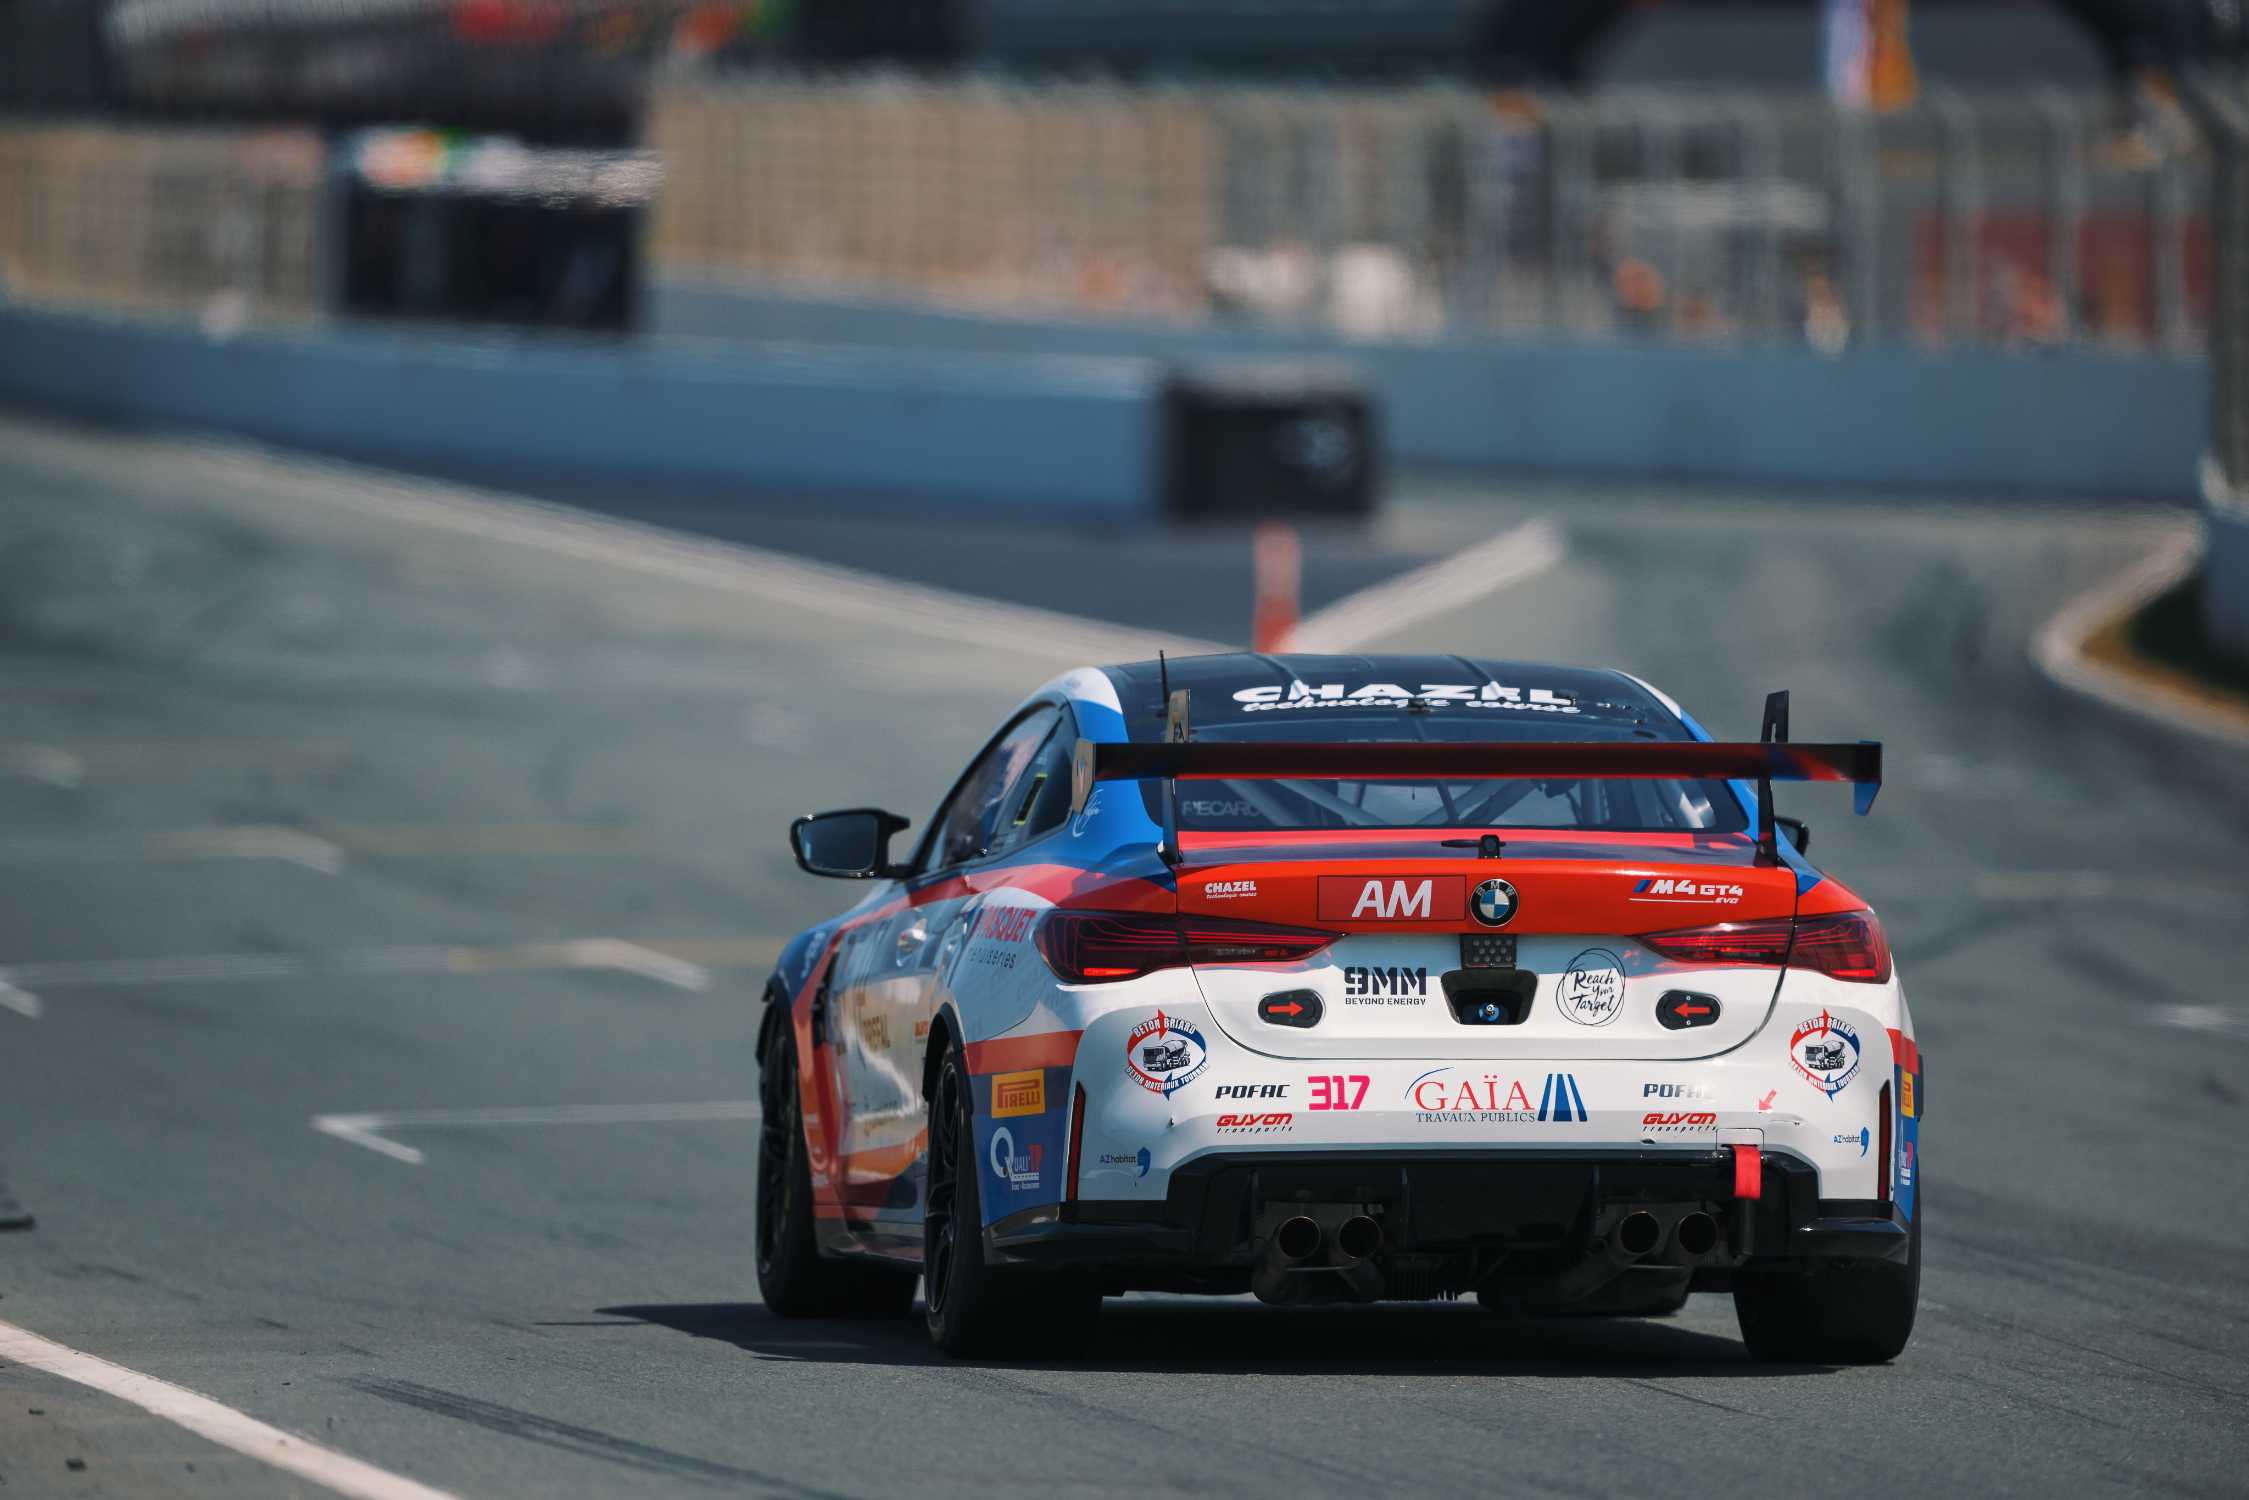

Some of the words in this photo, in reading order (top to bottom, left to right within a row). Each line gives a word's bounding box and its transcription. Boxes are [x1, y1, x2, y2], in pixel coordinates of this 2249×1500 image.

[1232, 680, 1574, 706] CHAZEL
[1205, 880, 1257, 894] CHAZEL
[1351, 879, 1433, 918] AM
[1476, 880, 1515, 897] BMW
[1649, 879, 1697, 895] M4
[1699, 884, 1744, 896] GT4
[1344, 966, 1428, 995] 9MM
[1569, 966, 1615, 992] Reach
[1345, 997, 1385, 1006] BEYOND
[1387, 997, 1427, 1006] ENERGY
[997, 1079, 1040, 1109] PIRELLI
[1215, 1084, 1291, 1099] POFAC
[1307, 1075, 1370, 1111] 317
[1414, 1074, 1535, 1111] GAÏA
[1416, 1112, 1476, 1123] TRAVAUX
[1481, 1112, 1535, 1123] PUBLICS
